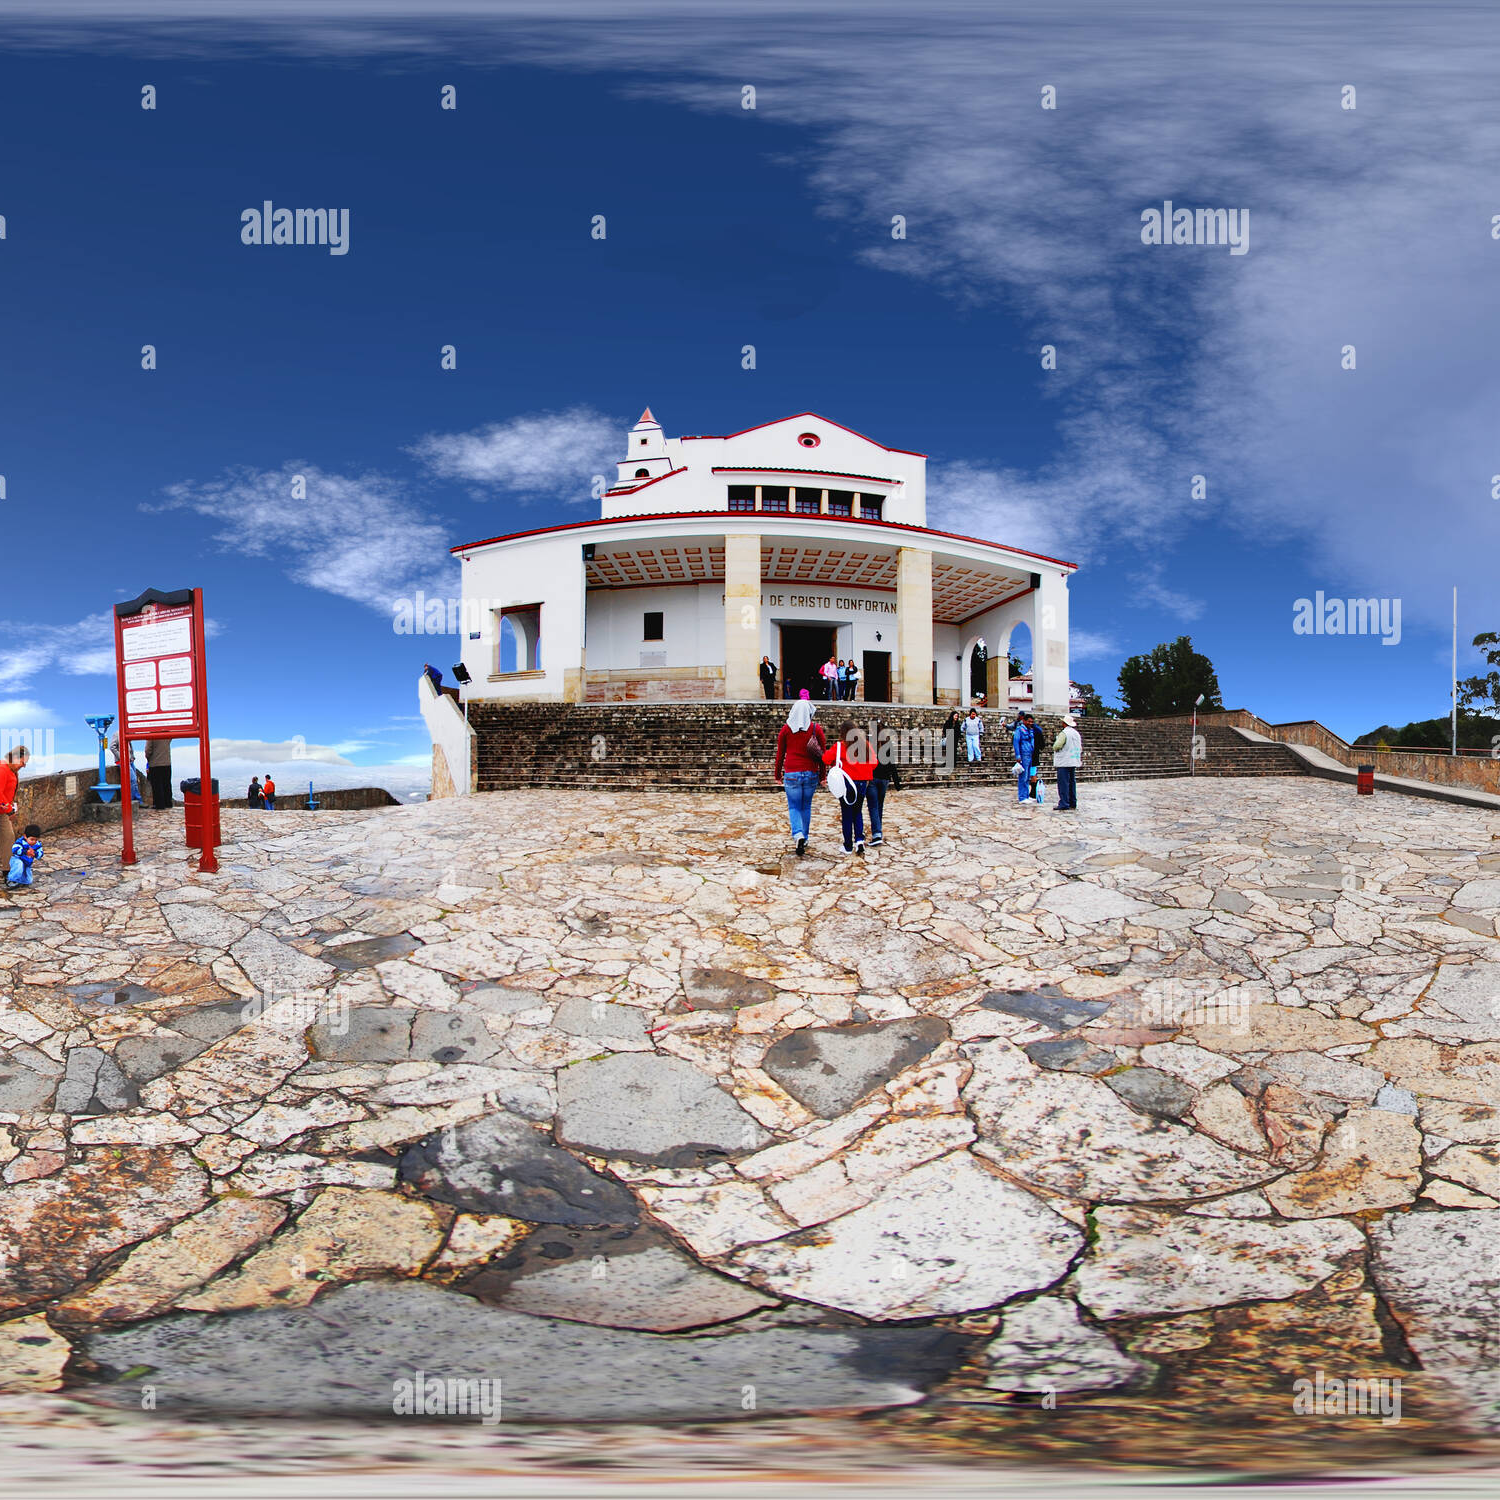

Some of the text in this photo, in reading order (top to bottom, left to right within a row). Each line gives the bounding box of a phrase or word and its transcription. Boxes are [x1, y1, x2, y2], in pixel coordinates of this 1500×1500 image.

[770, 595, 784, 606] DE
[791, 595, 830, 608] CRISTO
[836, 598, 897, 614] CONFORTAN
